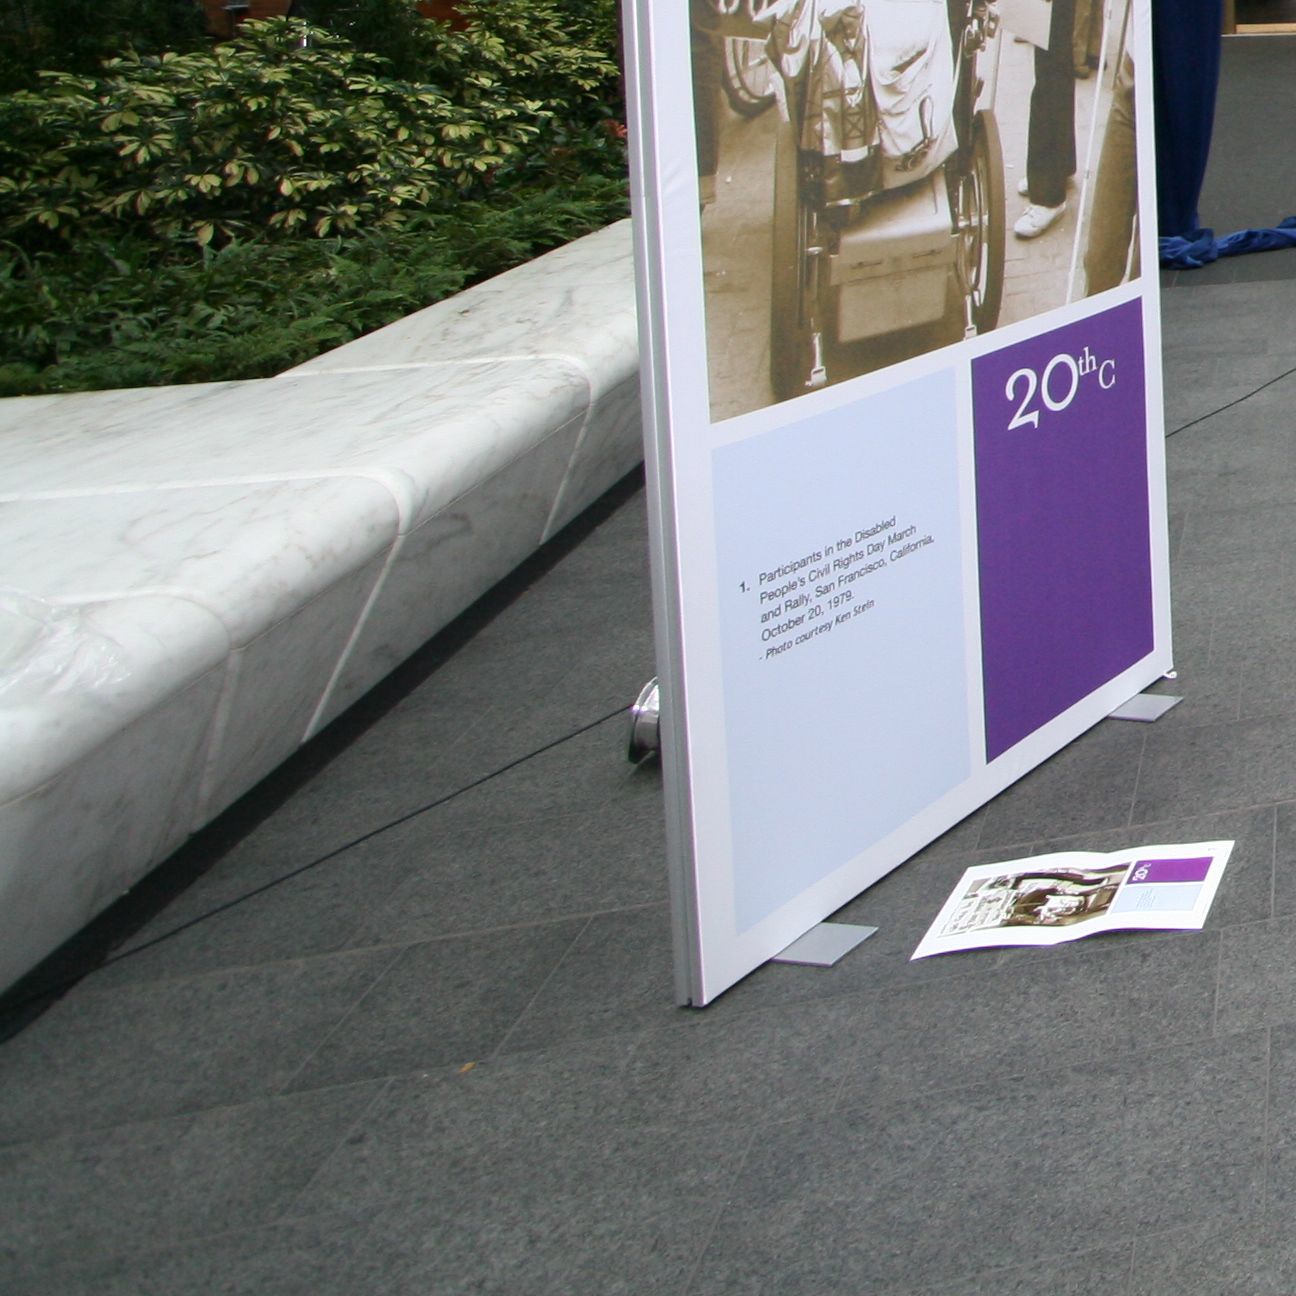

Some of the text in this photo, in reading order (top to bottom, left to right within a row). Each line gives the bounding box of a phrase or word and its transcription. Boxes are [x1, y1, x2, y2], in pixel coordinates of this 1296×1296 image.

[758, 550, 823, 586] Participants
[824, 545, 834, 557] in
[835, 537, 853, 552] the
[854, 515, 896, 544] Disabled
[807, 562, 831, 583] Civil
[832, 549, 865, 572] Rights
[866, 539, 886, 556] Day
[887, 524, 917, 546] March
[760, 603, 782, 624] and
[814, 581, 836, 598] San
[760, 613, 806, 642] October
[827, 589, 855, 610] 1979.
[765, 599, 875, 660] Photo courtesy Ken Stein
